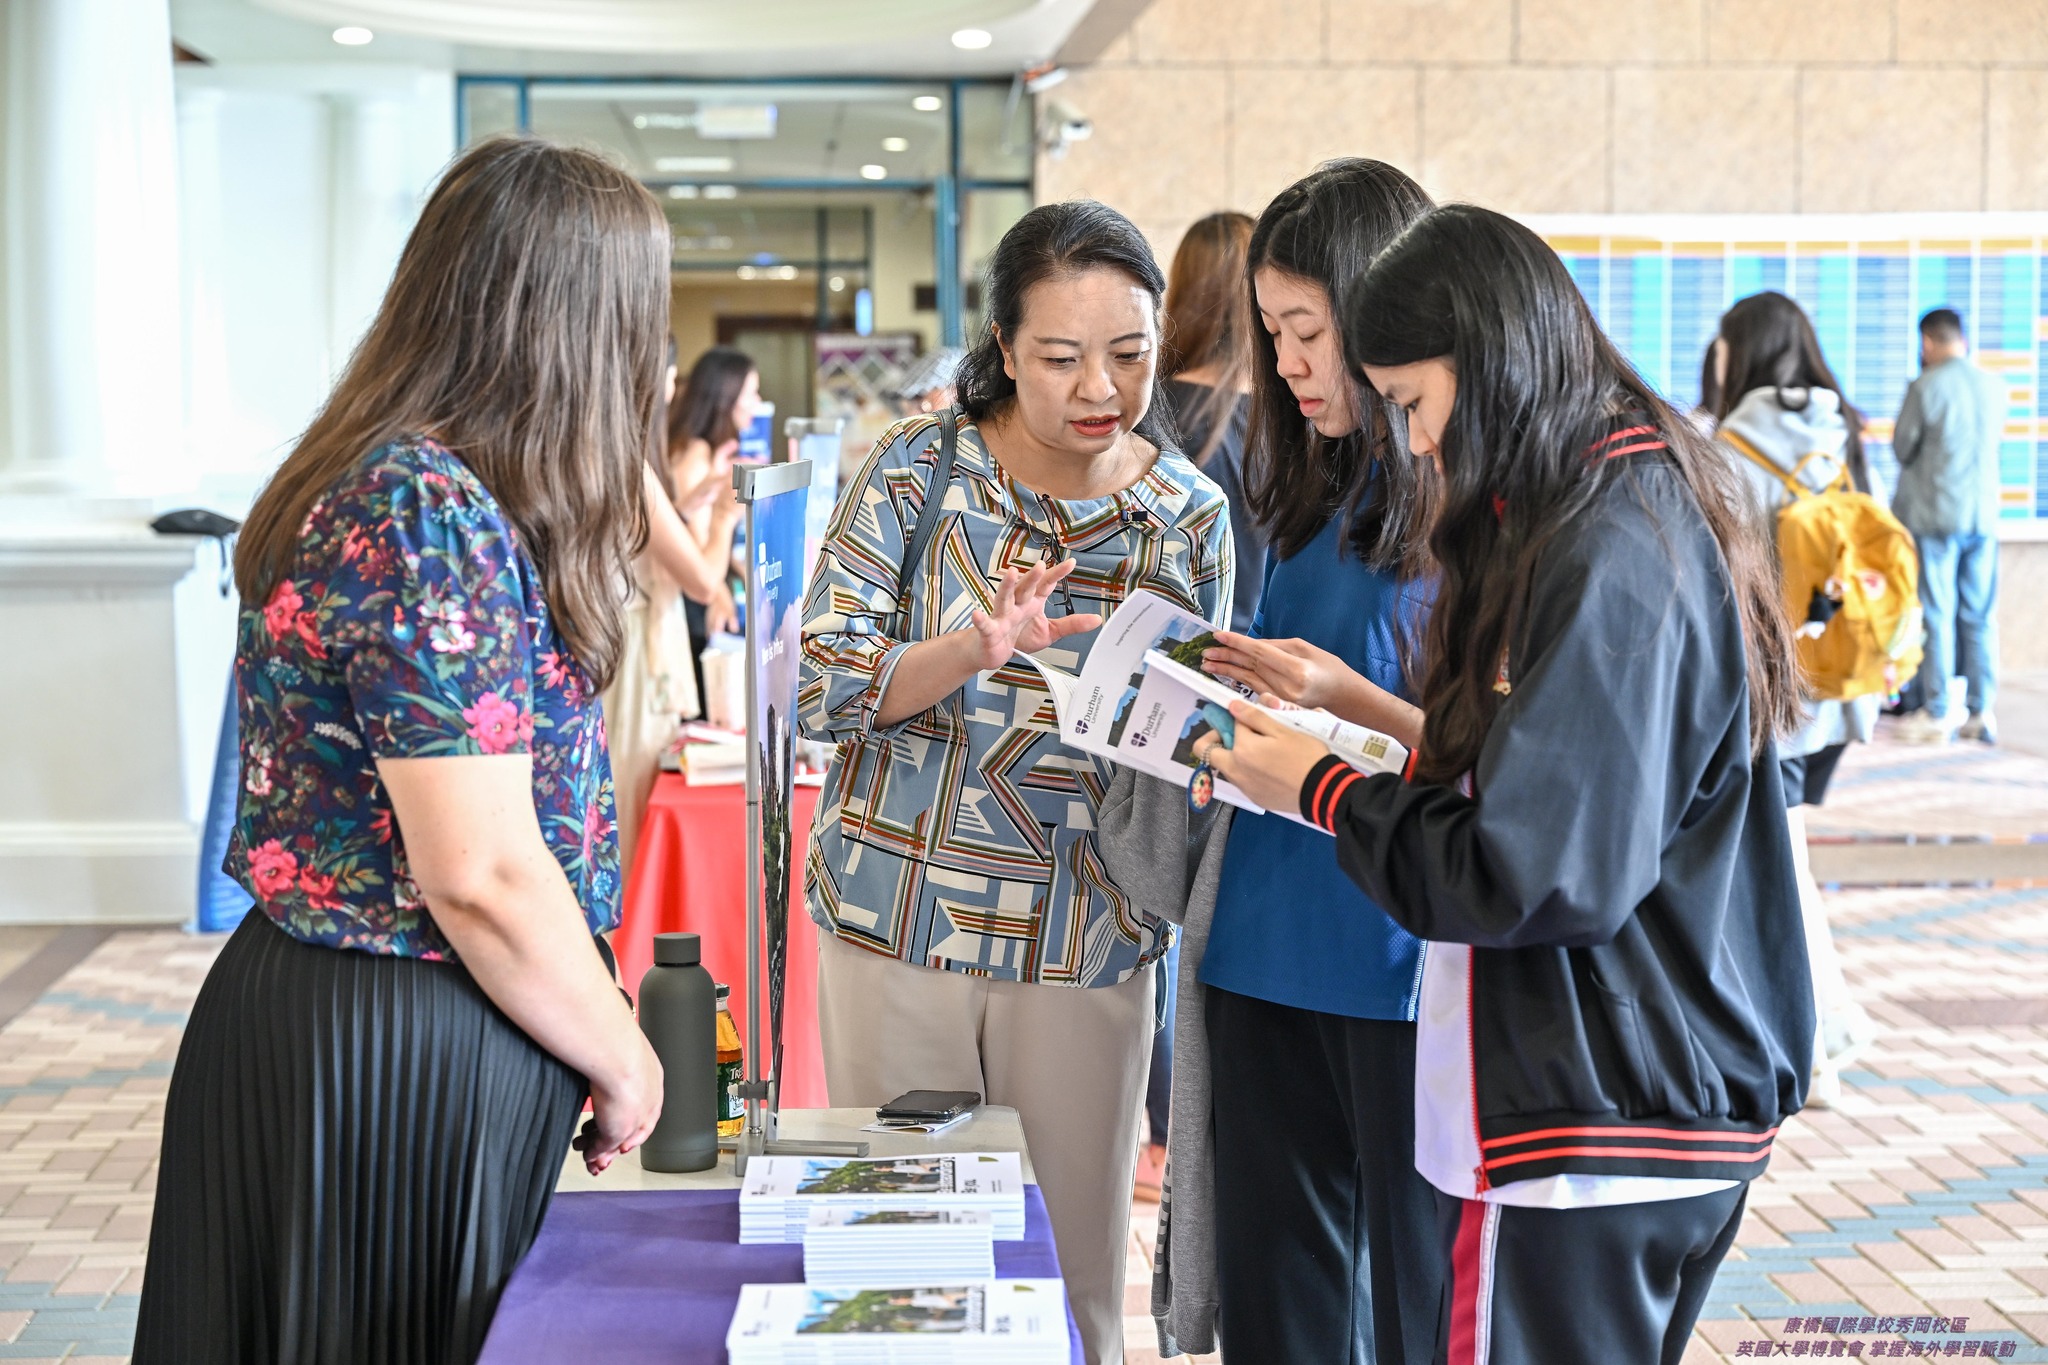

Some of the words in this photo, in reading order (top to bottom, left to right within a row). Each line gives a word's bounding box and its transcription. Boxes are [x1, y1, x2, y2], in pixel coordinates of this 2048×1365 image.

[1084, 686, 1101, 722] Durham
[1091, 694, 1104, 724] University
[1142, 702, 1162, 736] Durham
[1151, 711, 1167, 738] University
